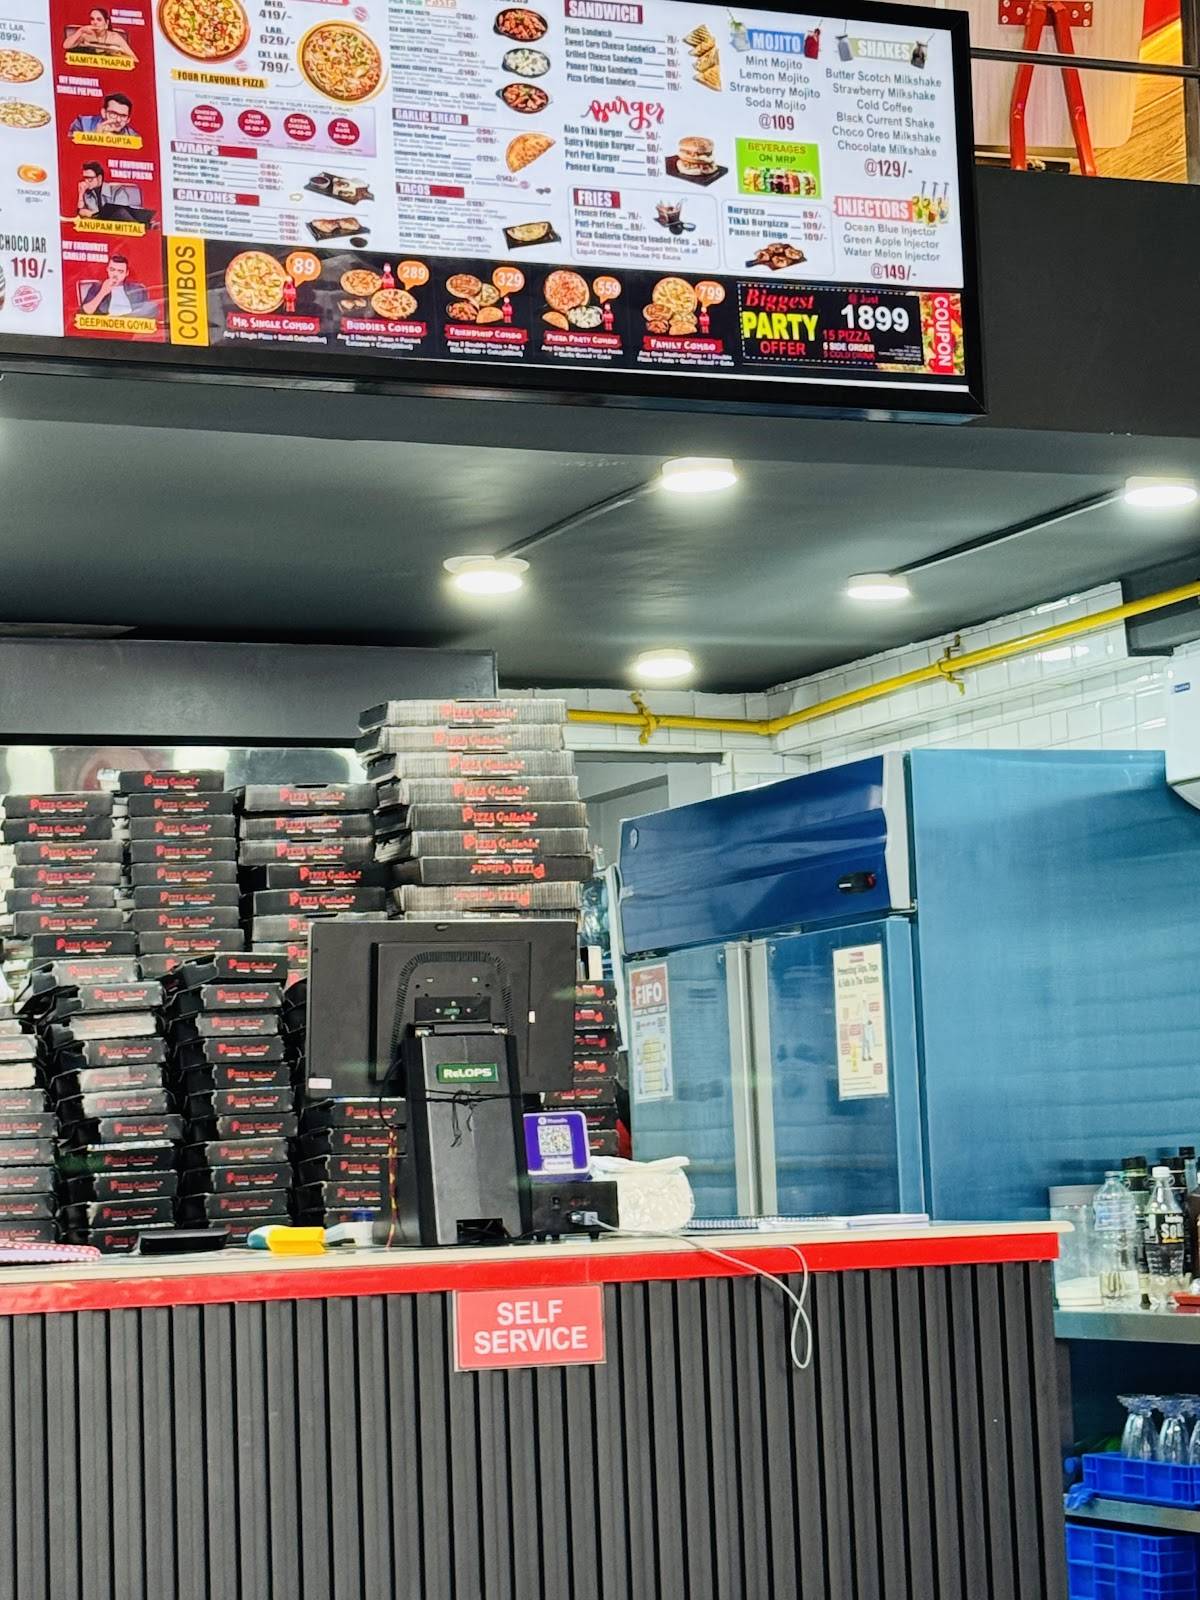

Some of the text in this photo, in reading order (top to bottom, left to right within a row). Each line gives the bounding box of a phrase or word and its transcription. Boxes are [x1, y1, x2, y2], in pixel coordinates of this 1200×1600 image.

[259, 9, 292, 20] 419/-
[568, 1, 639, 22] SANDWICH
[260, 34, 295, 46] 629/-
[582, 27, 612, 38] Sandwich
[565, 38, 657, 54] Sweet Corn Cheese Sandwich
[751, 32, 802, 52] MOJITO
[566, 50, 643, 65] Grilled Cheese Sandwich
[857, 41, 911, 61] SHAKES
[69, 55, 131, 67] NAMITA THAPAR
[260, 61, 294, 73] 799/-
[566, 61, 638, 76] Paneer Tikka Sandwich
[745, 56, 802, 71] Mint Mojito
[178, 71, 265, 88] FOUR FLAVOURE PIZZA
[567, 73, 636, 88] Pizza Grilled Sandwich
[739, 69, 810, 85] Lemon Mojito
[825, 68, 942, 88] Butter Scotch Milkshake
[729, 82, 821, 100] Strawberry Mojito
[832, 83, 936, 101] Strawberry Milkshake
[745, 97, 807, 112] Soda Mojito
[856, 100, 913, 113] Cold Coffee
[395, 110, 463, 124] GARLIC BREAD
[580, 95, 665, 131] Burger
[836, 112, 935, 129] Black Current Shake
[758, 114, 795, 130] @109
[81, 134, 132, 145] AMAN GUPTA
[564, 125, 579, 133] Aloo
[580, 126, 598, 135] Tikki
[599, 128, 623, 139] Burger
[832, 126, 941, 145] Choco Oreo Milkshake
[174, 142, 219, 156] WRAPS
[585, 139, 610, 150] Veggie
[611, 141, 635, 152] Burger
[748, 142, 807, 155] BEVERAGES
[838, 141, 938, 158] Chocolate Milkshake
[597, 152, 620, 163] Burger
[759, 154, 796, 164] ON MRP
[565, 161, 591, 172] Paneer
[864, 159, 914, 179] @129/-
[176, 191, 237, 204] CALZONES
[399, 183, 431, 197] TACOS
[577, 190, 613, 207] FRIES
[600, 210, 617, 219] Fries
[727, 206, 766, 217] Burgizza
[836, 199, 910, 220] INJECTORS
[78, 220, 144, 234] ANUPAM MITTAL
[606, 222, 623, 231] Fries
[728, 217, 755, 227] Tikki
[728, 228, 761, 238] Paneer
[762, 230, 788, 241] Bingo
[844, 222, 937, 238] Ocean Blue Injector
[0, 234, 47, 253] CHOCO JAR
[576, 230, 593, 239] Pizza
[673, 237, 690, 246] Fries
[843, 234, 940, 251] Green Apple Injector
[844, 247, 941, 264] Water Melon Injector
[11, 257, 53, 279] 119/-
[294, 257, 315, 276] 89
[402, 266, 427, 280] 289
[870, 263, 917, 281] @149/-
[498, 272, 523, 287] 329
[176, 245, 199, 340] COMBOS
[599, 281, 620, 295] 559
[700, 286, 723, 300] 799
[746, 288, 815, 312] Biggest
[79, 316, 154, 331] DEEPINDER GOYAL
[840, 304, 910, 333] 1899
[742, 311, 819, 342] PARTY
[933, 296, 953, 367] COUPON
[837, 331, 871, 343] PIZZA
[760, 342, 806, 356] OFFER
[829, 343, 848, 352] SIDE
[848, 344, 875, 353] ORDER
[635, 982, 662, 1005] FIFO
[496, 1299, 563, 1326] SELF
[474, 1326, 588, 1355] SERVICE
